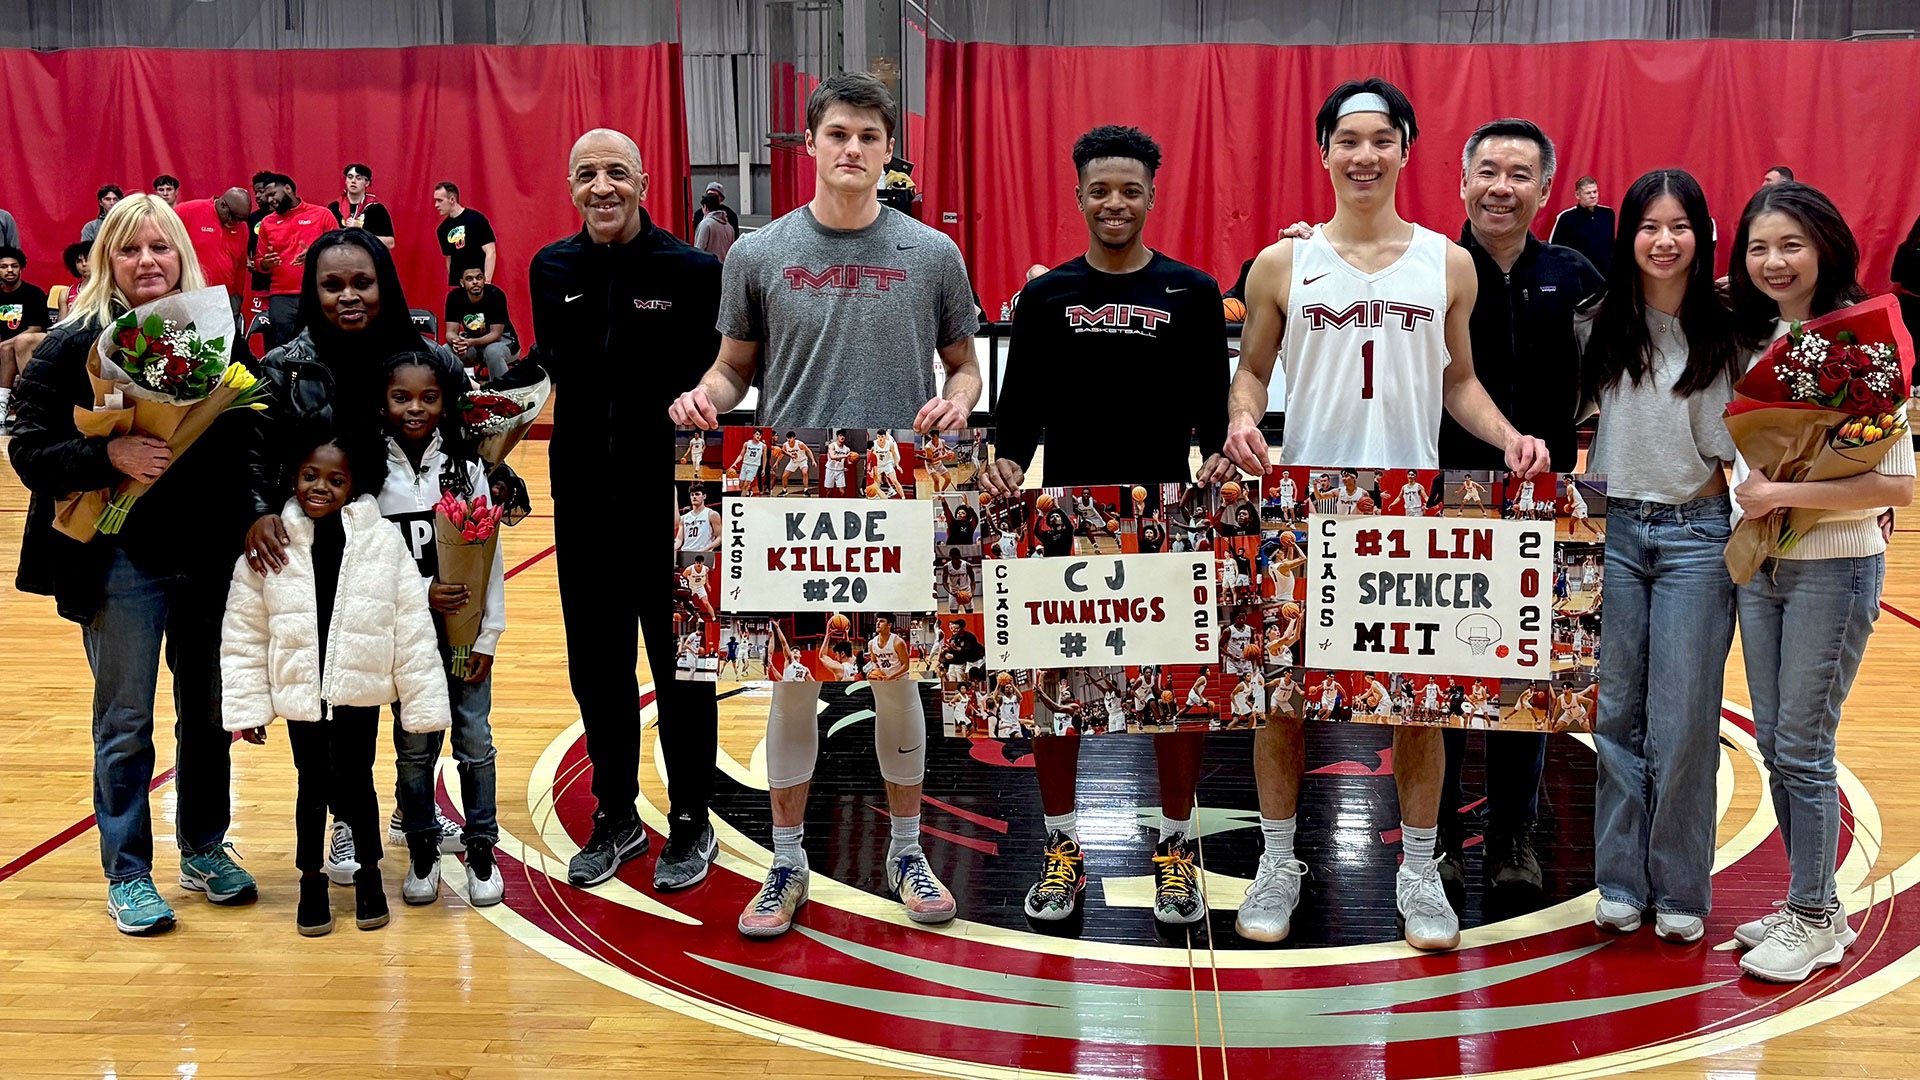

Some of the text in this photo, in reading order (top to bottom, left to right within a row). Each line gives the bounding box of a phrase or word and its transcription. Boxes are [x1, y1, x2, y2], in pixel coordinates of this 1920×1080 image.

[783, 265, 906, 291] MIT
[633, 299, 672, 310] MIT
[1065, 303, 1171, 330] MIT
[1302, 300, 1435, 332] MIT
[1075, 327, 1157, 338] BASKETBALL
[1361, 340, 1374, 399] 1
[731, 503, 745, 579] CLASS
[785, 511, 887, 542] KADE
[767, 546, 902, 573] KILLEEN
[1355, 528, 1493, 560] #1 LIN
[803, 576, 868, 603] #20
[1321, 520, 1337, 627] CLASS
[996, 565, 1009, 645] CLASS
[1358, 571, 1493, 609] SPENCER
[1516, 532, 1541, 667] 2025
[1025, 597, 1166, 625] TUMMINGS
[1192, 563, 1209, 652] 2025
[1353, 622, 1440, 655] MIT
